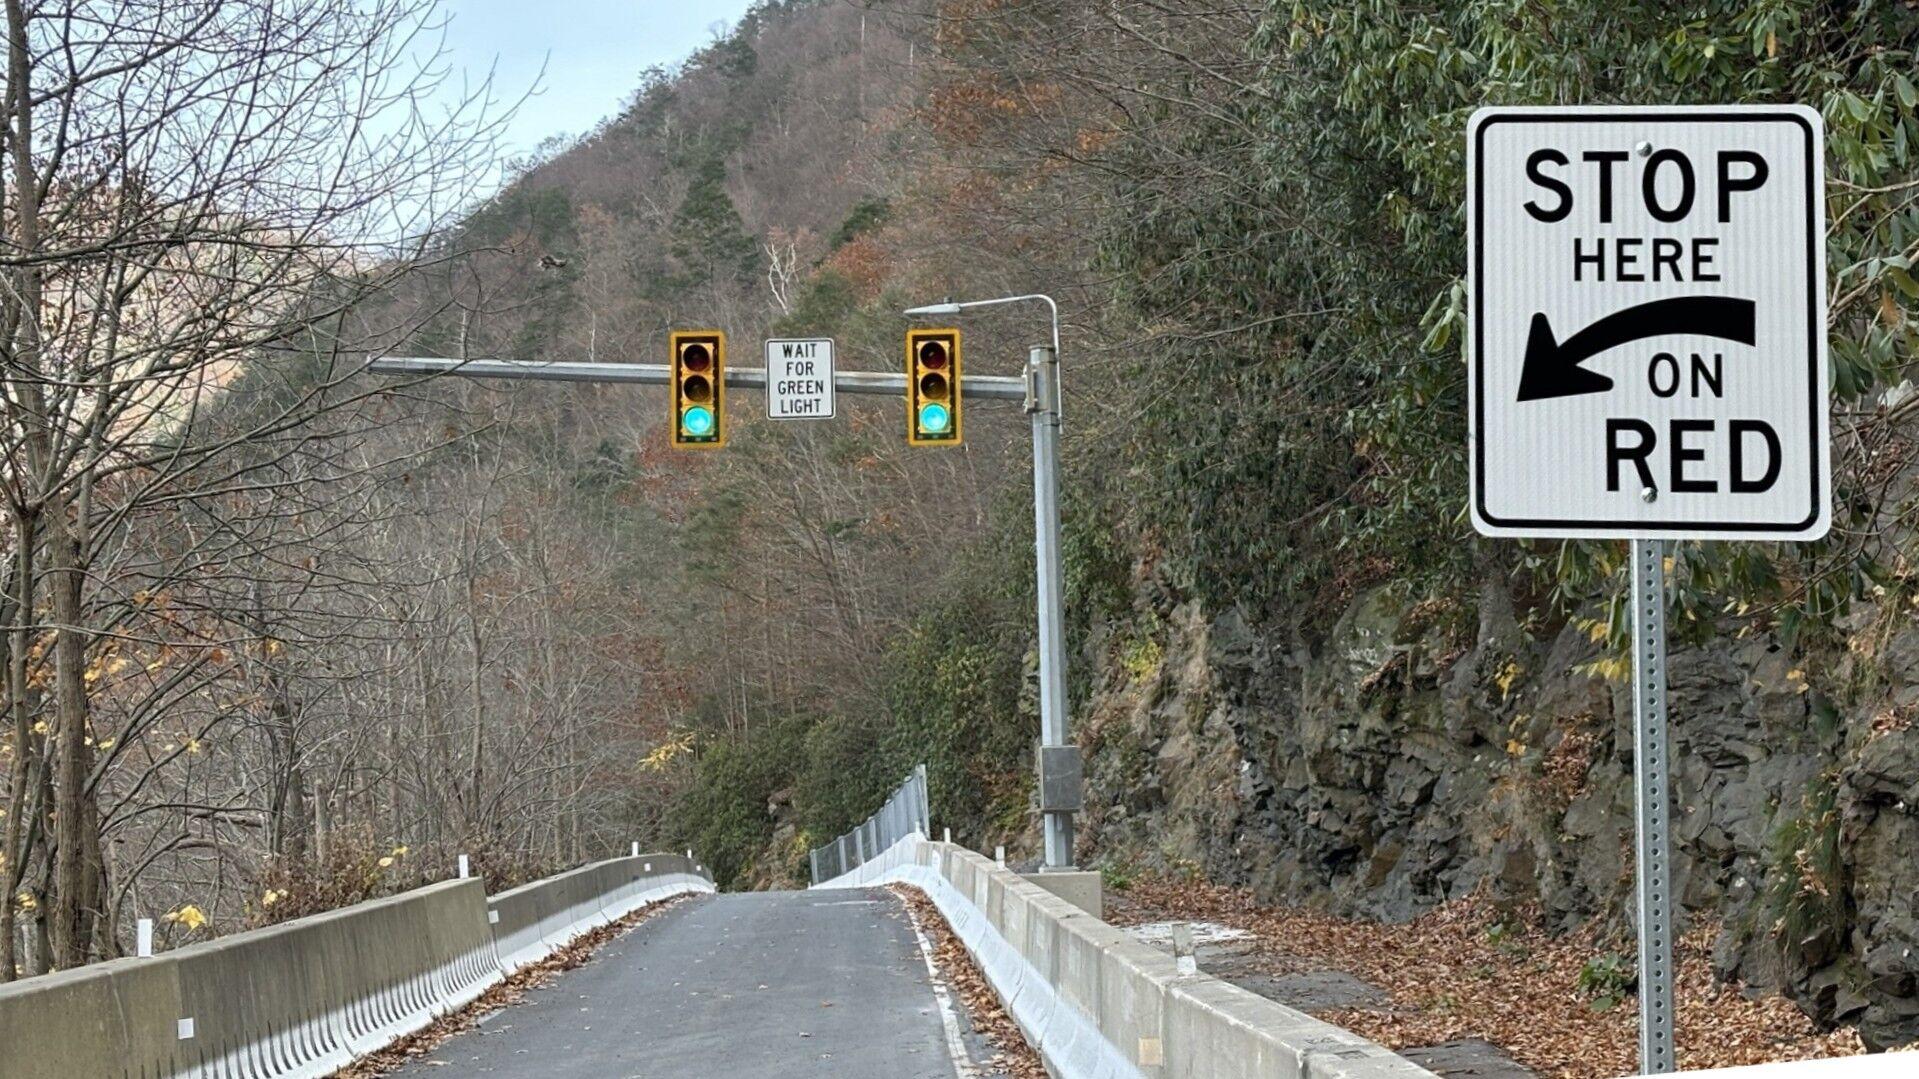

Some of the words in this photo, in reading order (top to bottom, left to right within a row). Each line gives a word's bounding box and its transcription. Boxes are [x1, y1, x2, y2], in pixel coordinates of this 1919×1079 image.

[1523, 148, 1769, 223] STOP
[1573, 237, 1721, 282] HERE
[782, 344, 817, 358] WAIT
[786, 362, 814, 376] FOR
[1648, 352, 1723, 398] ON
[778, 380, 824, 395] GREEN
[780, 399, 821, 414] LIGHT
[1606, 418, 1782, 494] RED
